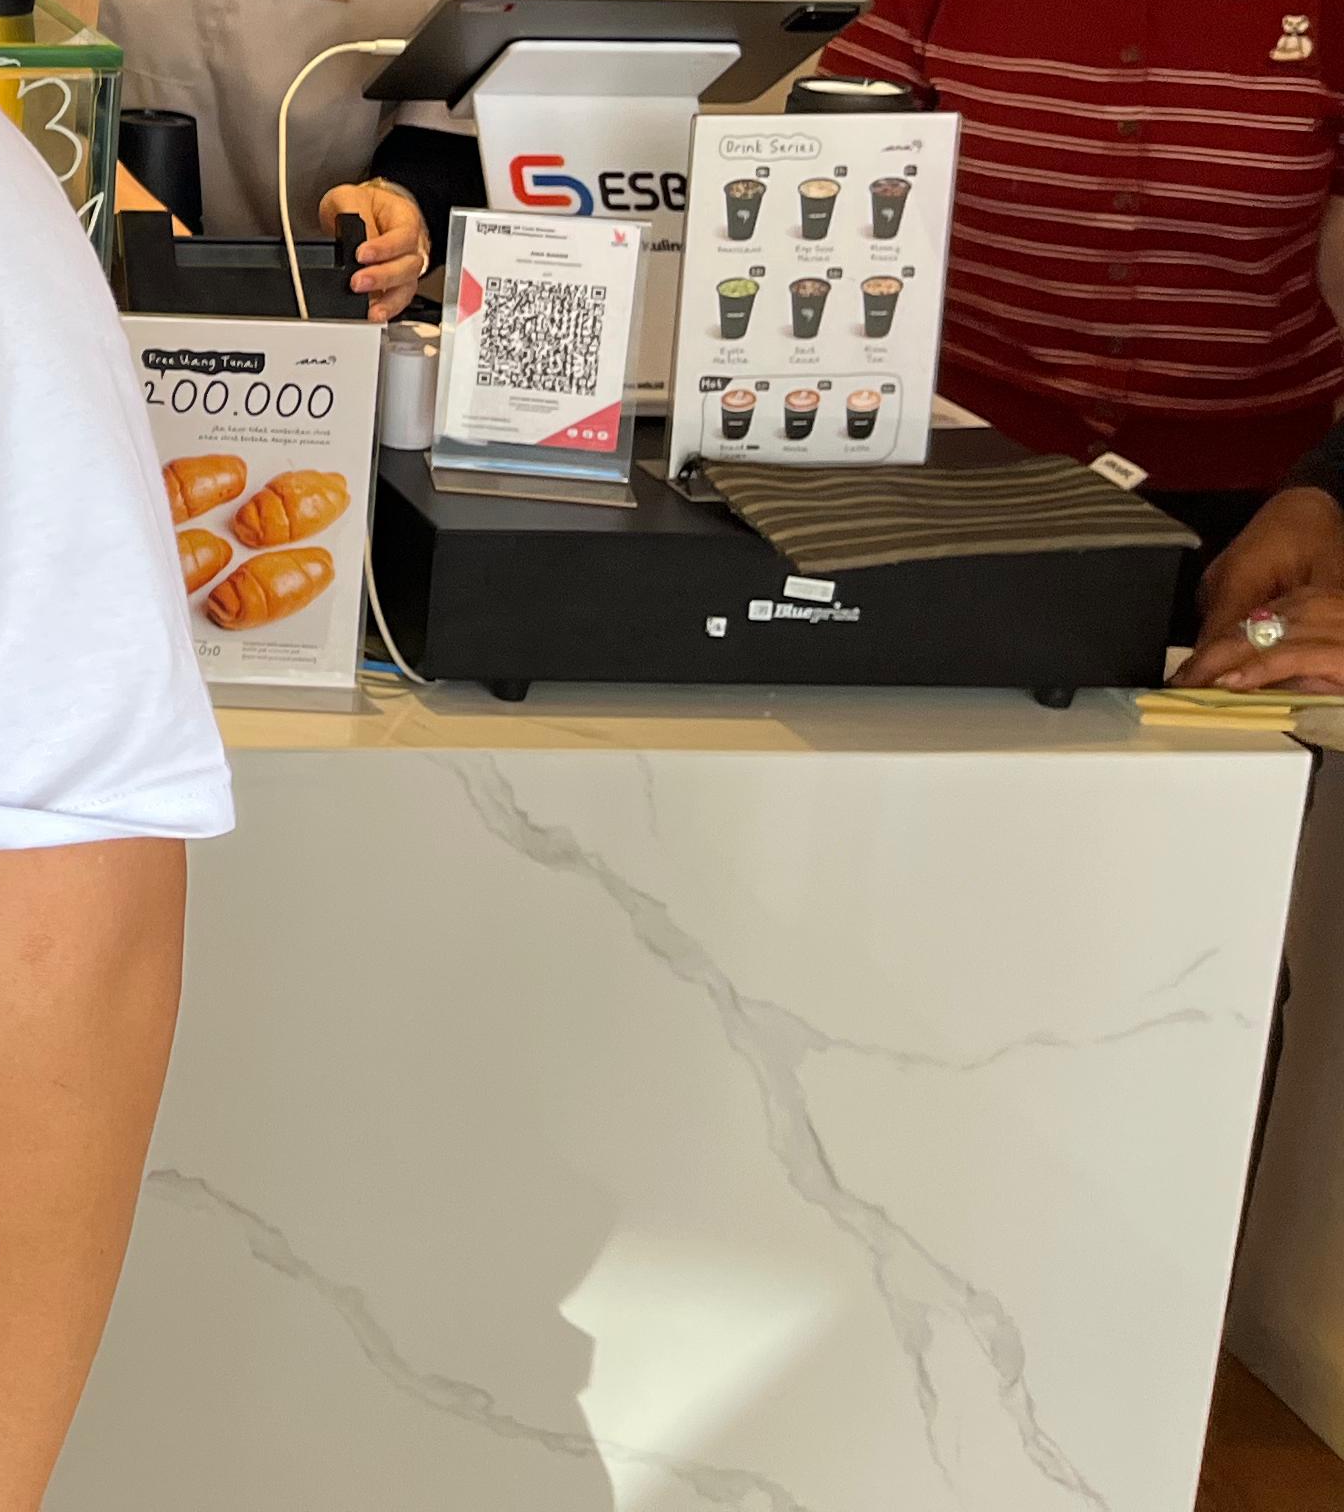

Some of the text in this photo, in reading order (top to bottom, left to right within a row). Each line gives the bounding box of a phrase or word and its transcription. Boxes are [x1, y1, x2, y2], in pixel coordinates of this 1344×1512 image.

[725, 138, 814, 154] Drink Series
[148, 353, 258, 371] Free Uang Tunai
[144, 379, 335, 419] 200.000
